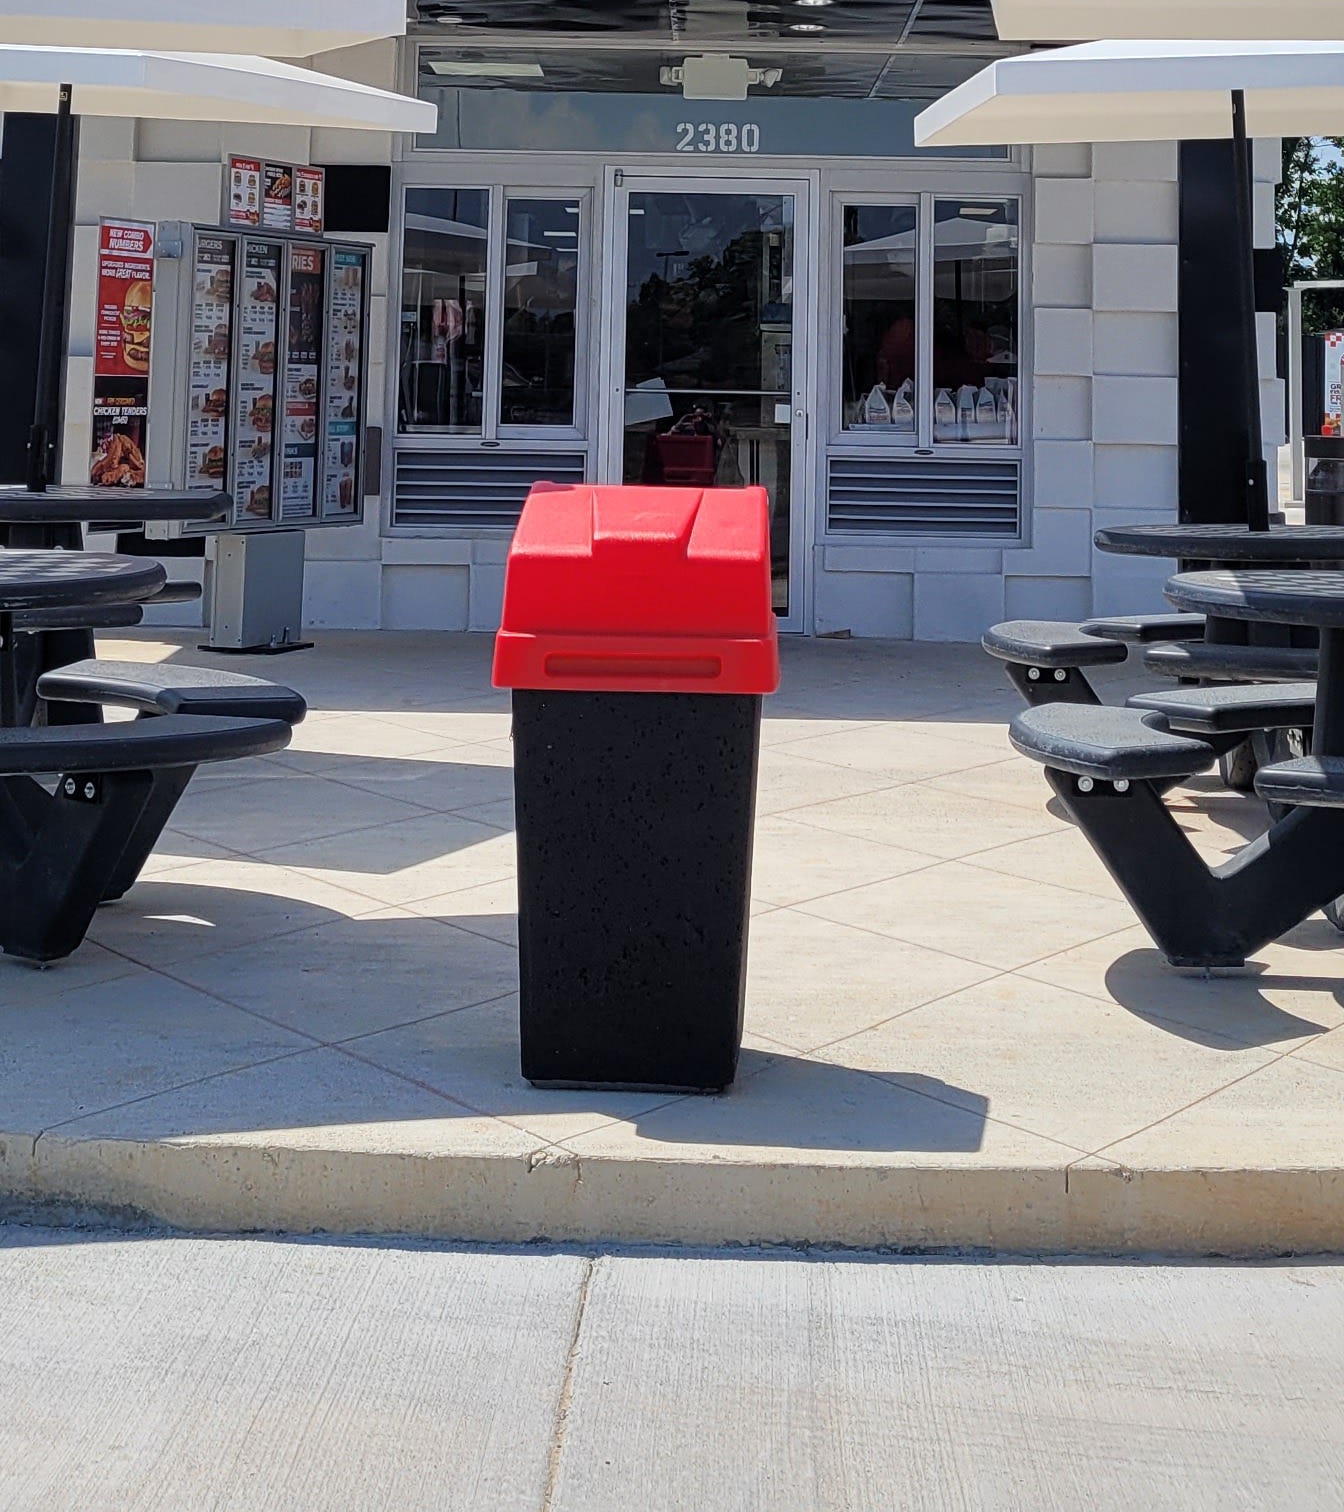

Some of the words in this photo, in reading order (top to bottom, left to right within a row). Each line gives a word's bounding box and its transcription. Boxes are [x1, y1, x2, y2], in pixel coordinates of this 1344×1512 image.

[676, 122, 760, 152] 2380
[109, 238, 144, 251] NUMBERS
[198, 239, 223, 250] URGERS
[292, 255, 314, 271] RIES
[93, 406, 120, 416] CHICKEN
[121, 406, 147, 416] TENDERS
